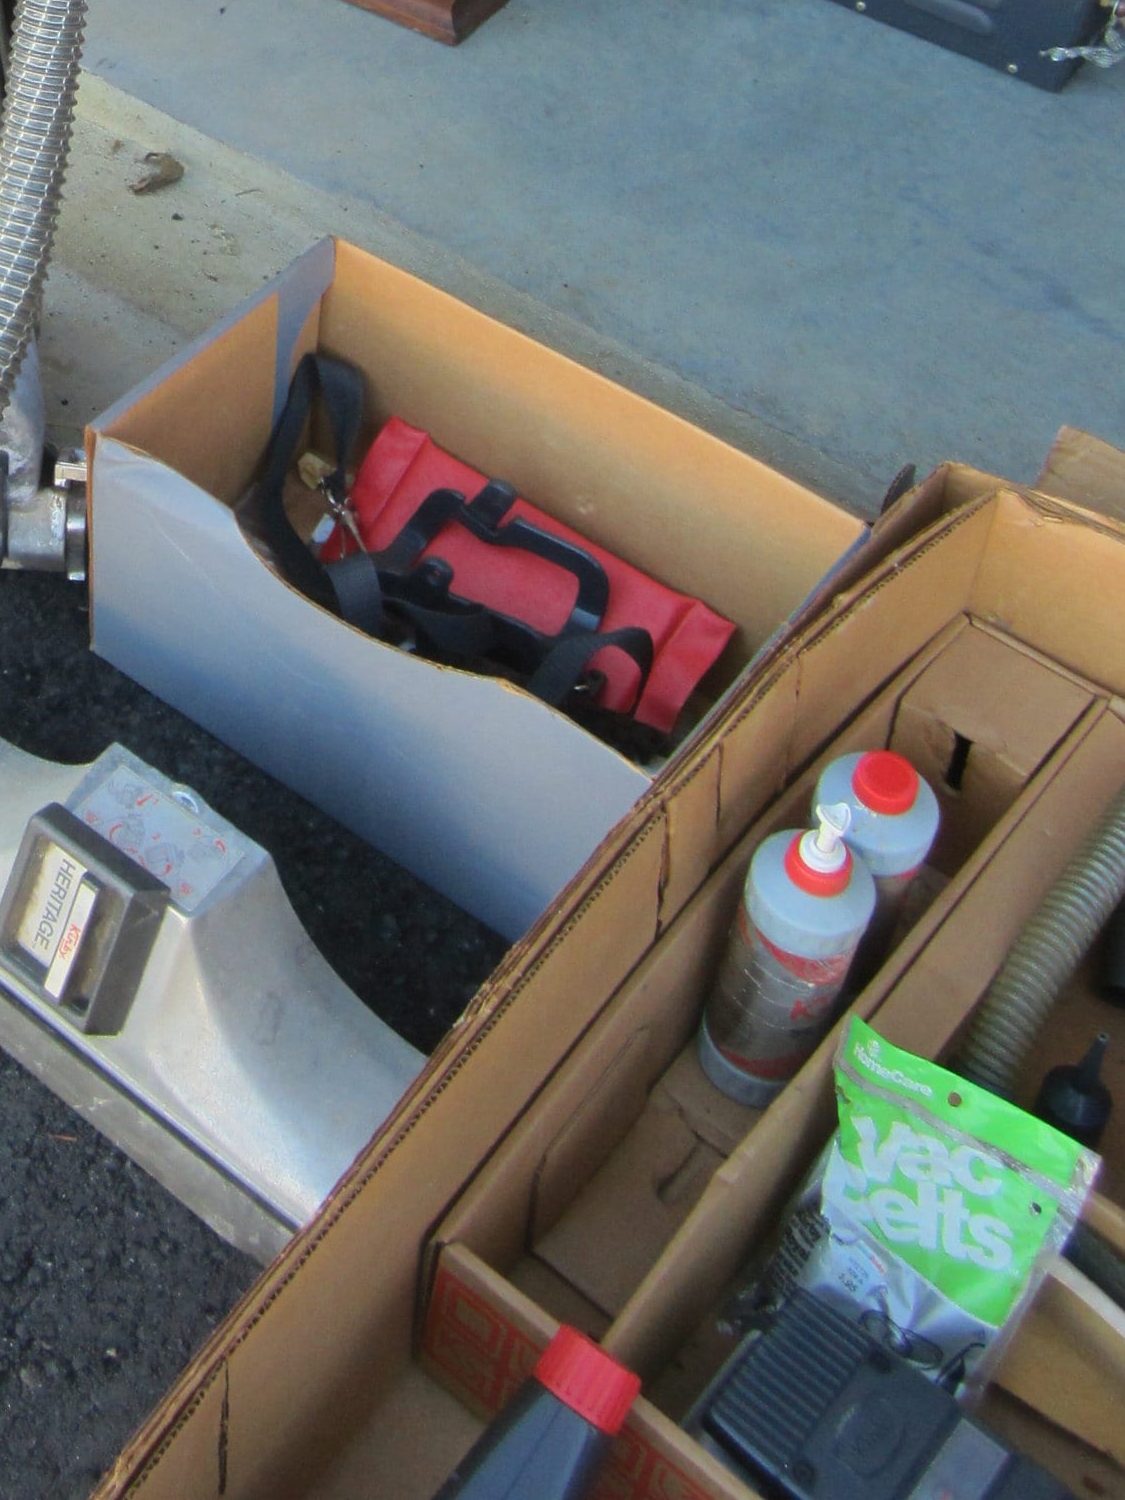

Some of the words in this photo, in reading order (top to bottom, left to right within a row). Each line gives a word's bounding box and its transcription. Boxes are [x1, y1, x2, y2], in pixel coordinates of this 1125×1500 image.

[33, 858, 77, 950] HERITAGE
[58, 923, 82, 961] Kirby
[853, 1042, 934, 1098] HomeCare
